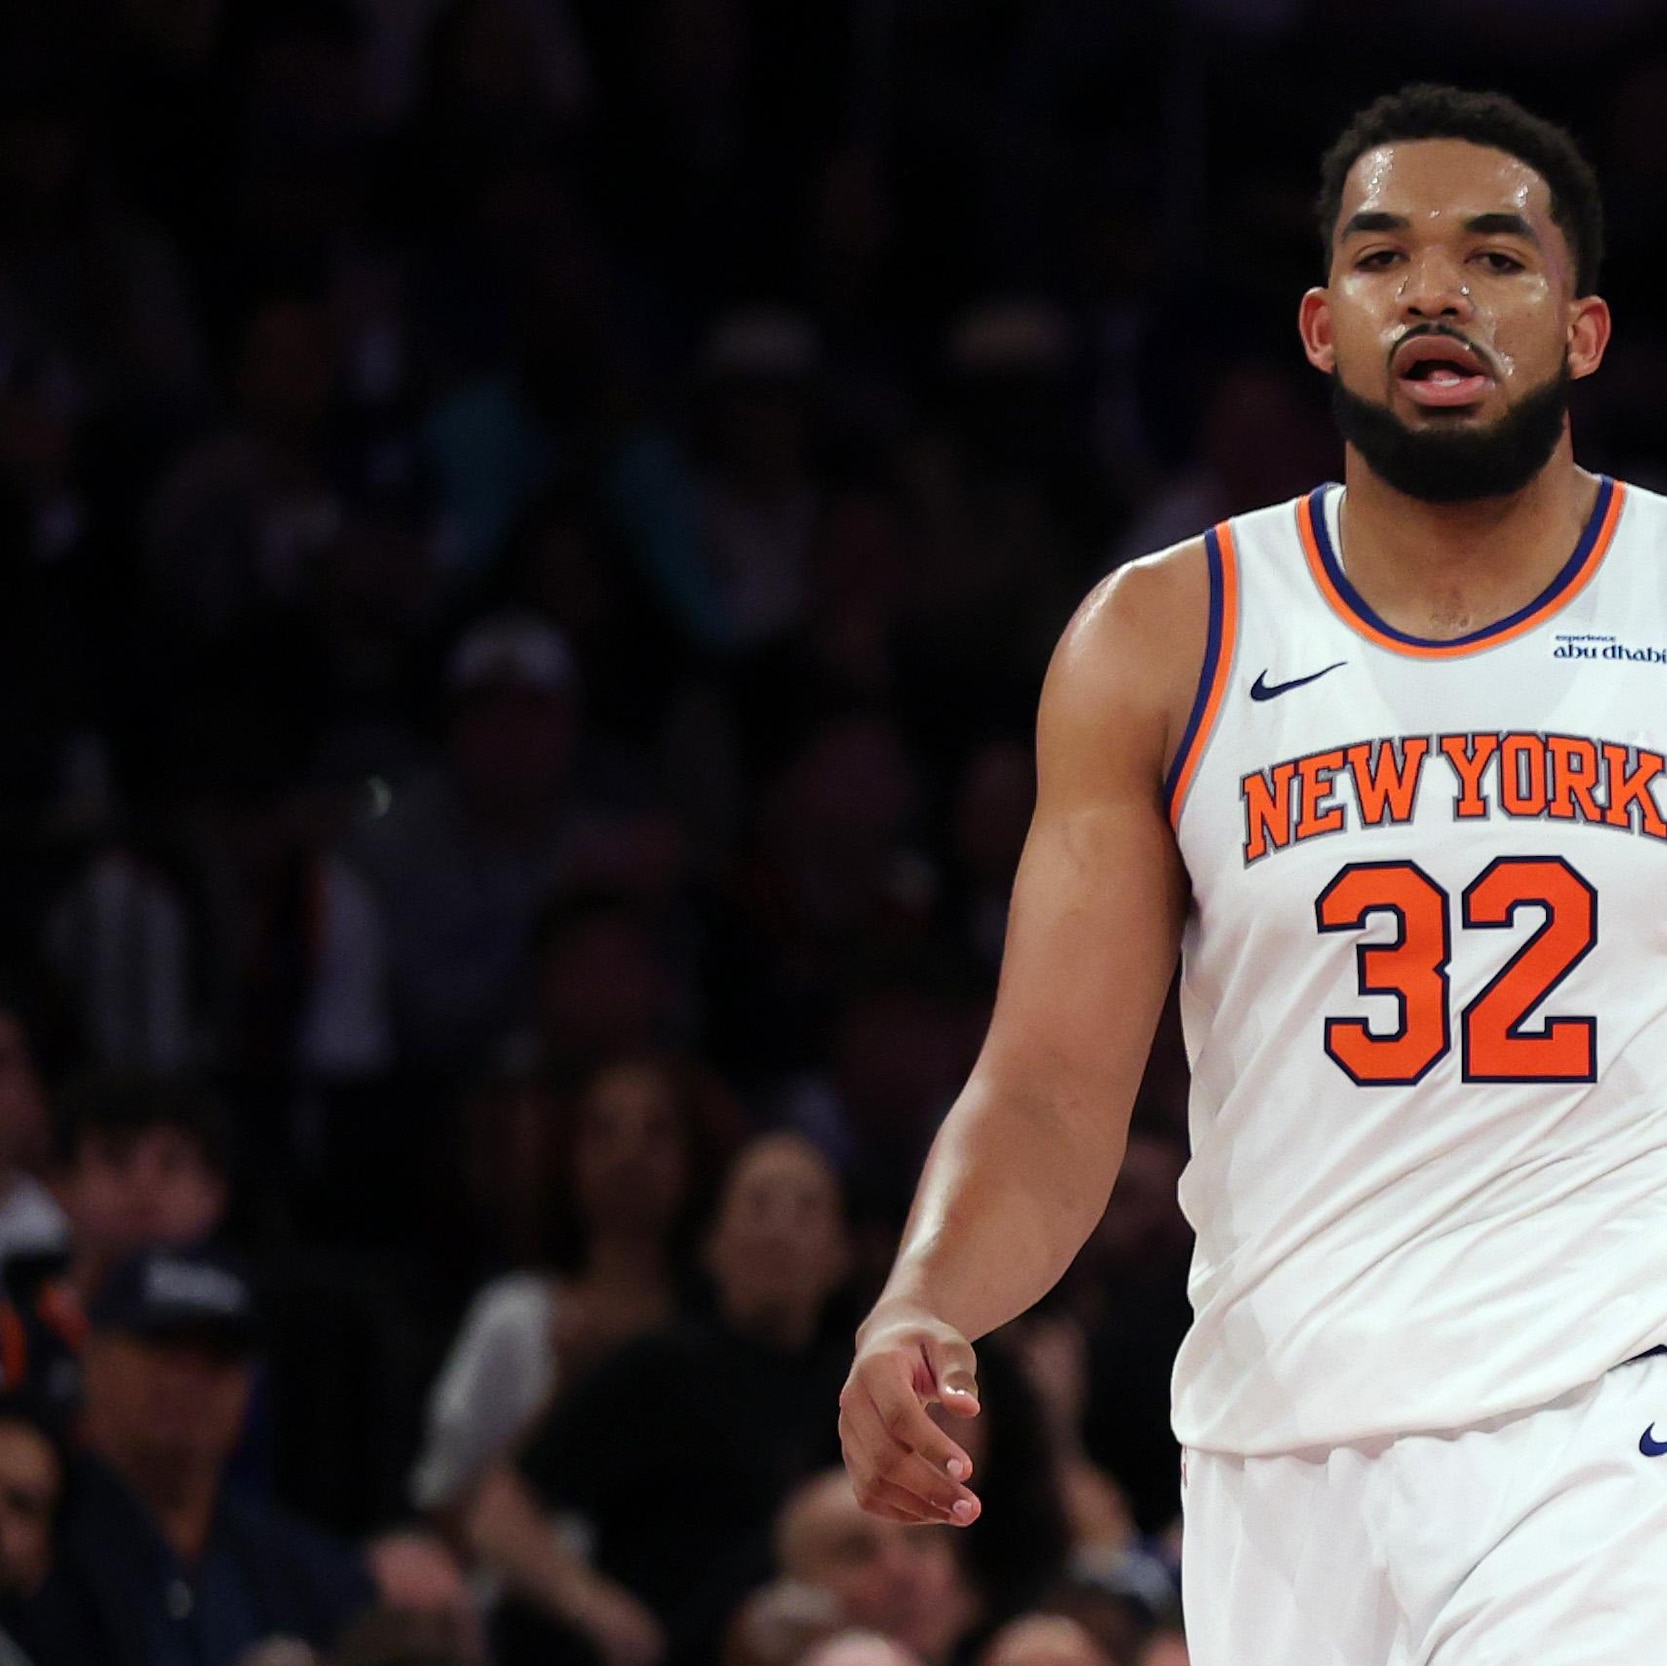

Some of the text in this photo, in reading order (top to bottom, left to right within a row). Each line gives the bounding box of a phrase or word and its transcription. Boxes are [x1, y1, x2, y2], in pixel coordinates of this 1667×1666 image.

[1553, 644, 1667, 664] abu dhabi
[1239, 733, 1431, 870] NEW
[1314, 855, 1599, 1087] 32
